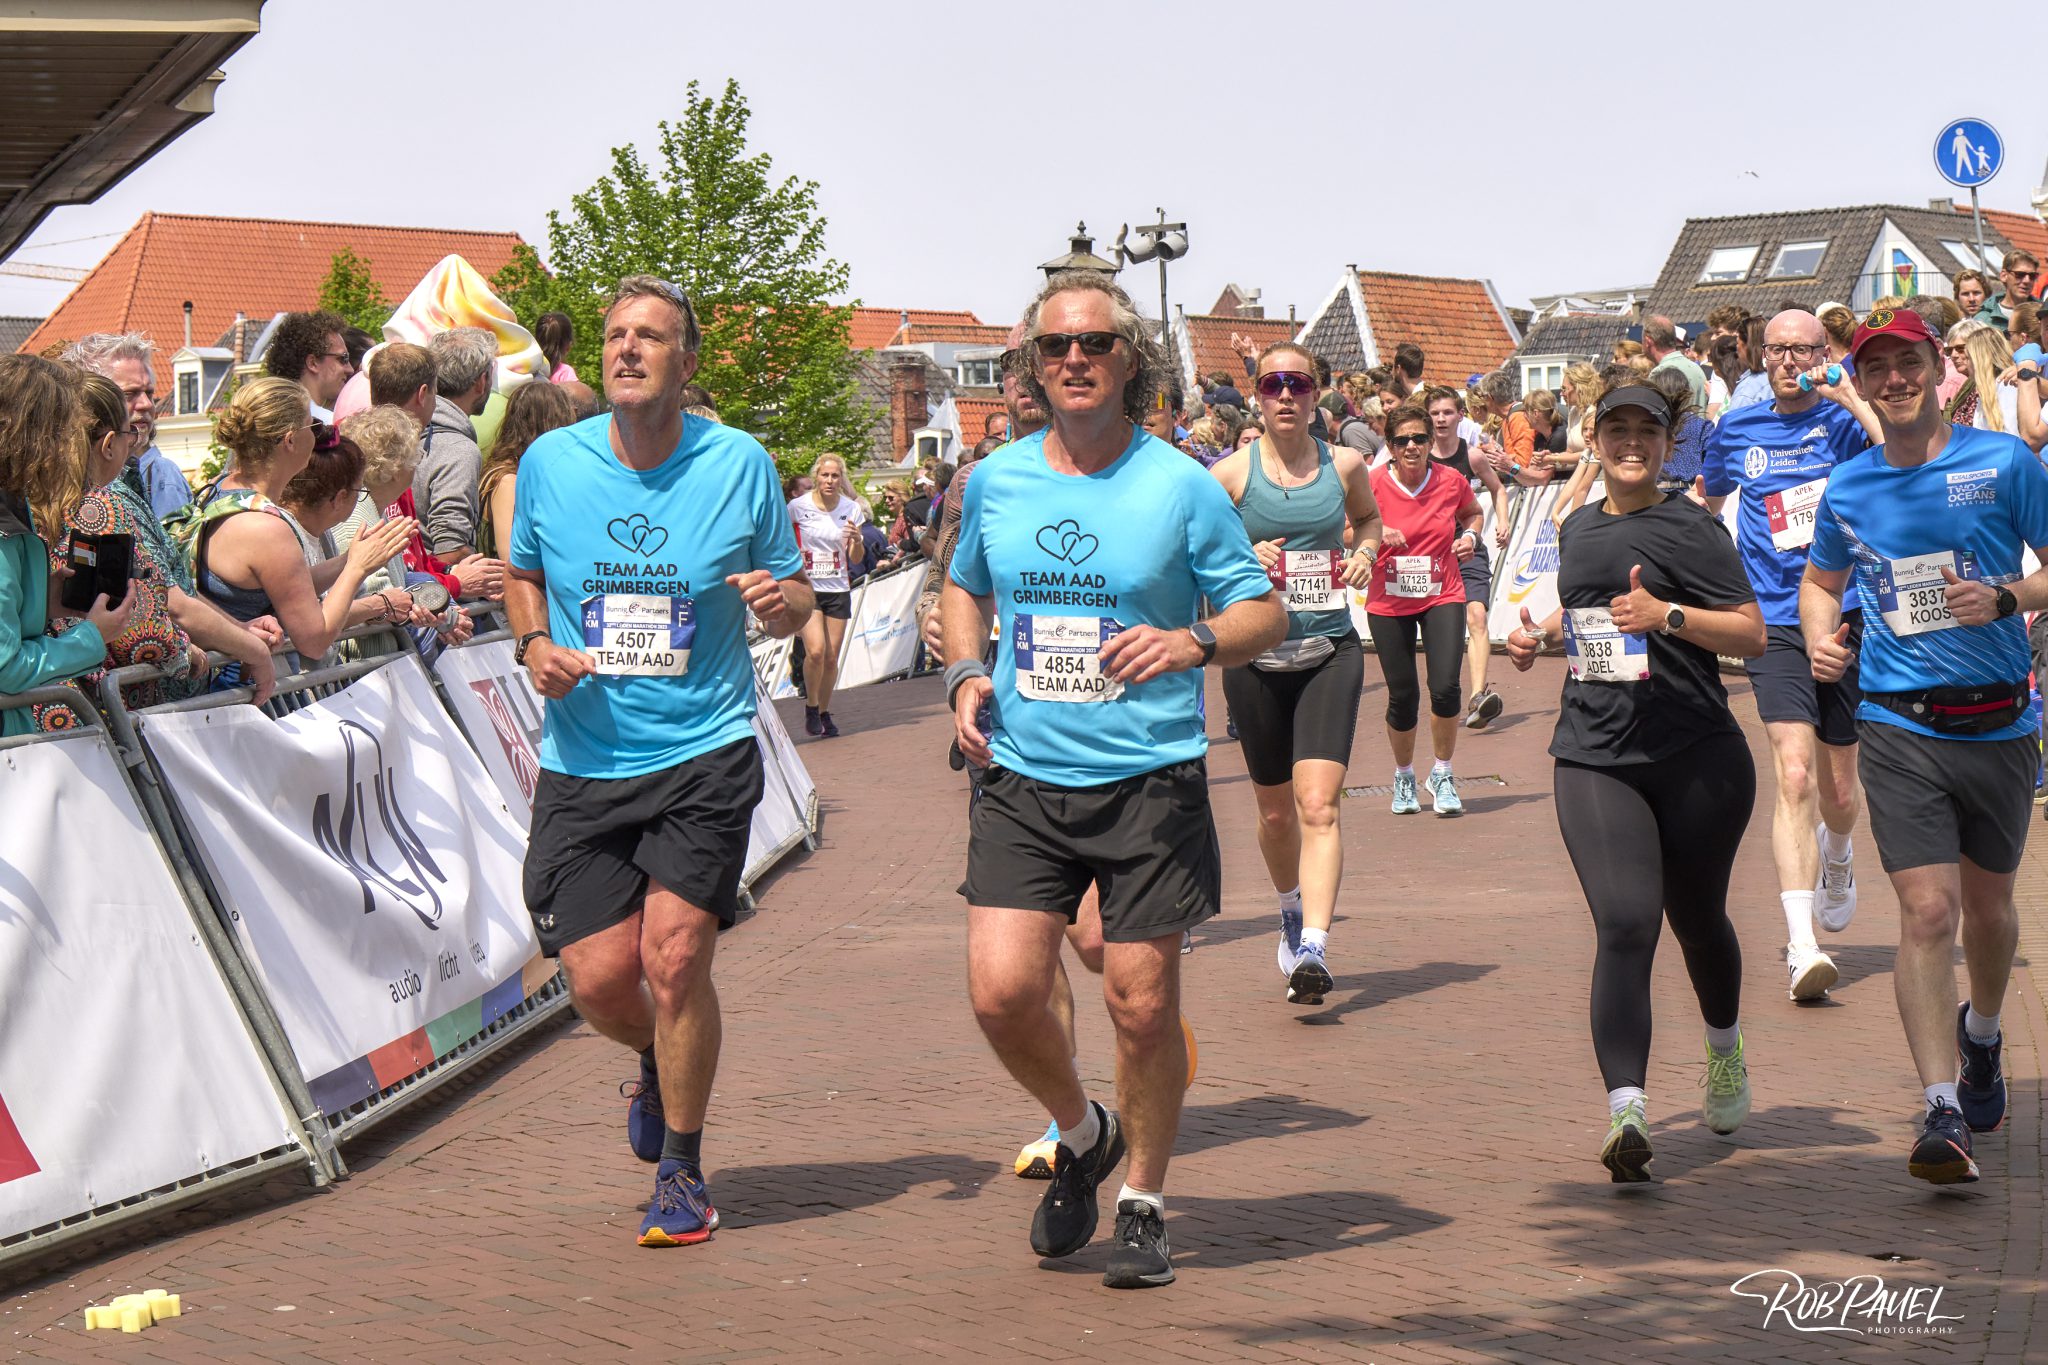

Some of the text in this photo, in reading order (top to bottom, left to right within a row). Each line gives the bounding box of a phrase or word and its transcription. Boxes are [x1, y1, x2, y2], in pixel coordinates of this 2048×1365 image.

[1770, 445, 1814, 458] Universiteit
[1770, 459, 1798, 467] Leiden
[1794, 484, 1814, 497] APEK
[1947, 483, 1976, 494] TWO
[1948, 490, 1996, 503] OCEANS
[1948, 500, 1995, 508] MARATHON
[1771, 511, 1782, 520] KM
[1793, 510, 1816, 526] 179
[1299, 553, 1319, 561] APEK
[1527, 546, 1560, 573] MARATH
[594, 562, 678, 577] TEAM AAD
[1894, 568, 1915, 577] Bunnig
[1962, 561, 1972, 578] F
[1020, 571, 1106, 589] TEAM AAD
[1293, 578, 1326, 592] 17141
[1401, 575, 1427, 584] 17125
[1879, 577, 1888, 587] 21
[1907, 582, 1922, 590] LEIDEN
[1922, 579, 1945, 587] MARATHON
[582, 579, 690, 595] GRIMBERGEN
[1400, 585, 1428, 593] MARJO
[1879, 586, 1891, 595] KM
[1013, 589, 1118, 609] GRIMBERGEN
[1289, 593, 1330, 605] ASHLEY
[1909, 587, 1946, 608] 3837
[587, 610, 597, 619] 21
[641, 606, 669, 615] Partners
[1910, 607, 1952, 625] KOOS
[585, 619, 599, 628] KM
[678, 611, 689, 628] F
[1018, 631, 1027, 641] 21
[1034, 627, 1055, 637] Bunnig
[1068, 629, 1098, 637] Partners
[616, 631, 656, 649] 4507
[1016, 641, 1029, 651] KM
[1584, 641, 1613, 658] 3838
[598, 651, 675, 667] TEAM AAD
[1045, 655, 1086, 675] 4854
[1587, 657, 1615, 674] ADÉL
[1029, 674, 1106, 693] TEAM AAD
[389, 968, 422, 1004] audio
[438, 951, 461, 982] licht
